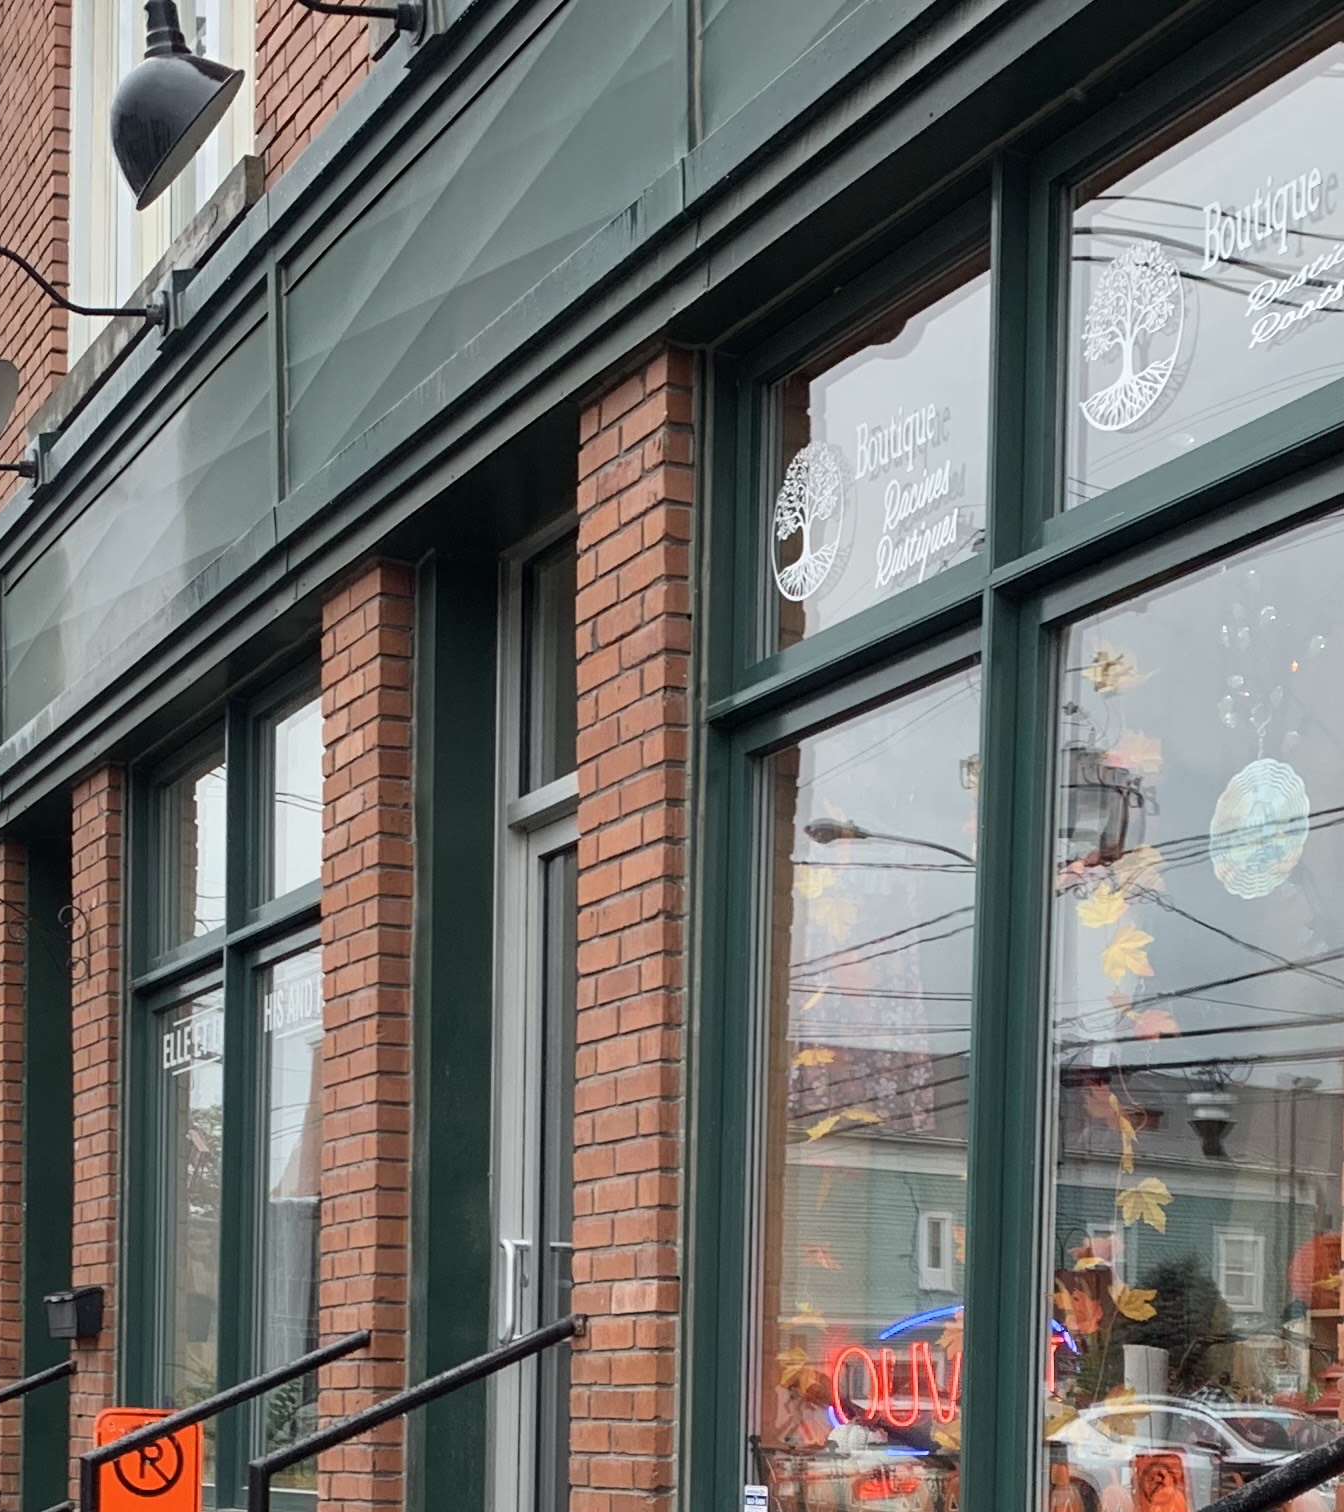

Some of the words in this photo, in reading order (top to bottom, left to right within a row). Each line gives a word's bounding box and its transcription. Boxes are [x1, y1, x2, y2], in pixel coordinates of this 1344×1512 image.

[1201, 167, 1322, 272] Boutique
[855, 403, 937, 480] Boutique
[882, 460, 951, 533] Racines
[874, 508, 958, 588] Rustiques
[162, 1026, 192, 1069] ELLE
[263, 989, 284, 1033] HIS
